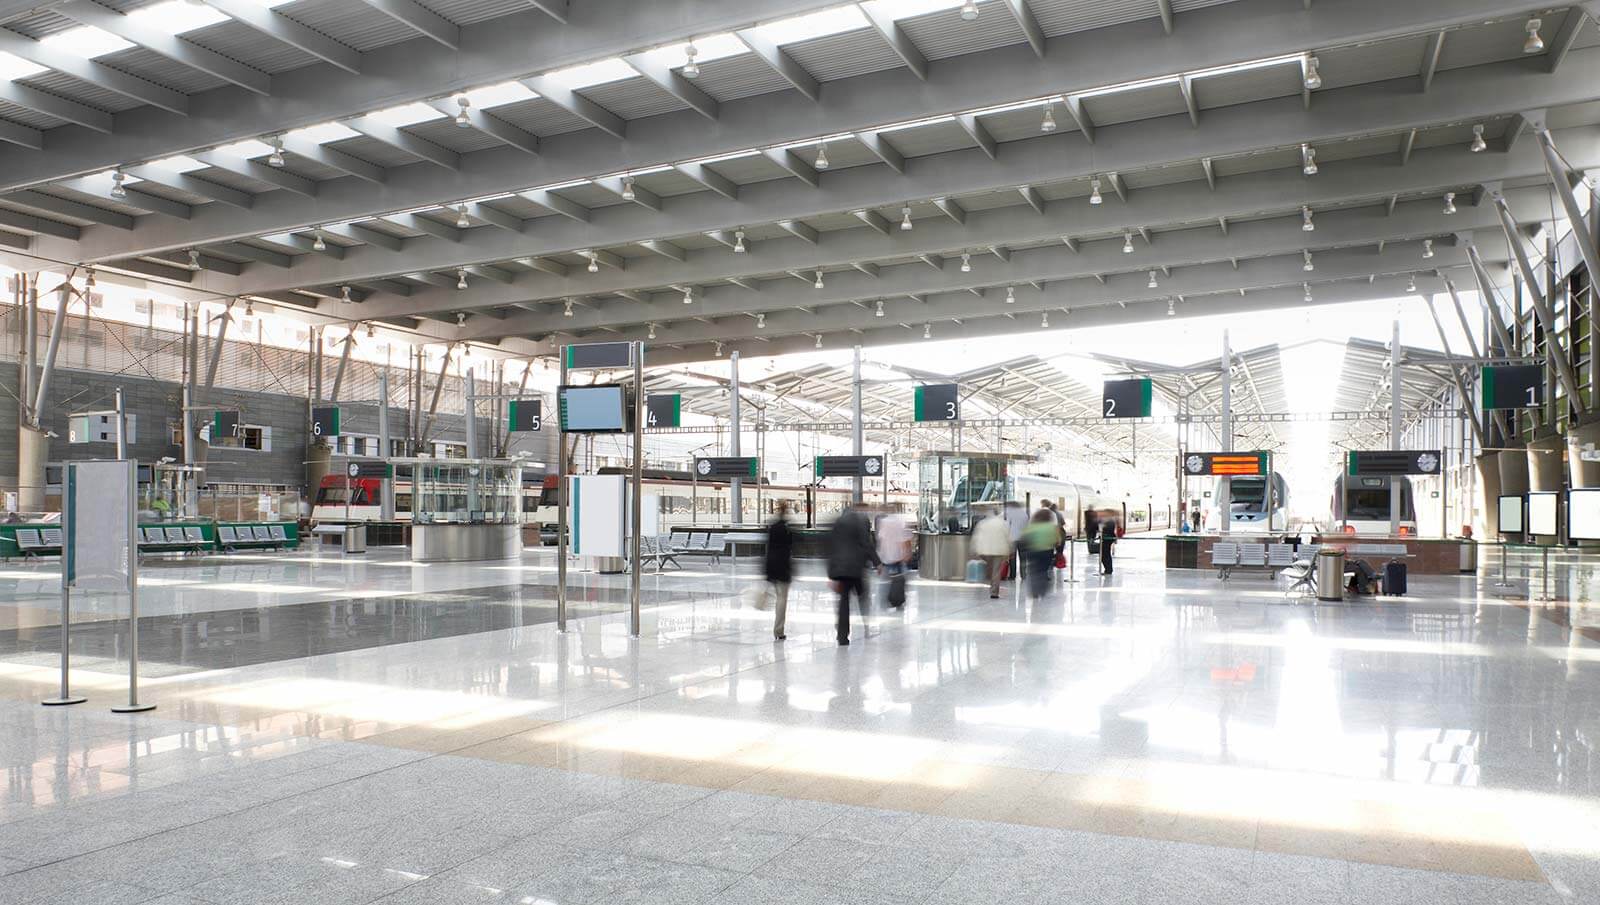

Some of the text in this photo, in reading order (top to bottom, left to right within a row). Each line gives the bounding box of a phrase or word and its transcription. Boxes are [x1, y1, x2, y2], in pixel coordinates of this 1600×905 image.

[1526, 387, 1540, 407] 1
[947, 402, 956, 420] 3
[1105, 399, 1116, 417] 2
[532, 415, 540, 430] 5
[648, 411, 657, 426] 4
[70, 430, 76, 442] 8
[231, 423, 238, 436] 7
[314, 421, 321, 436] 6
